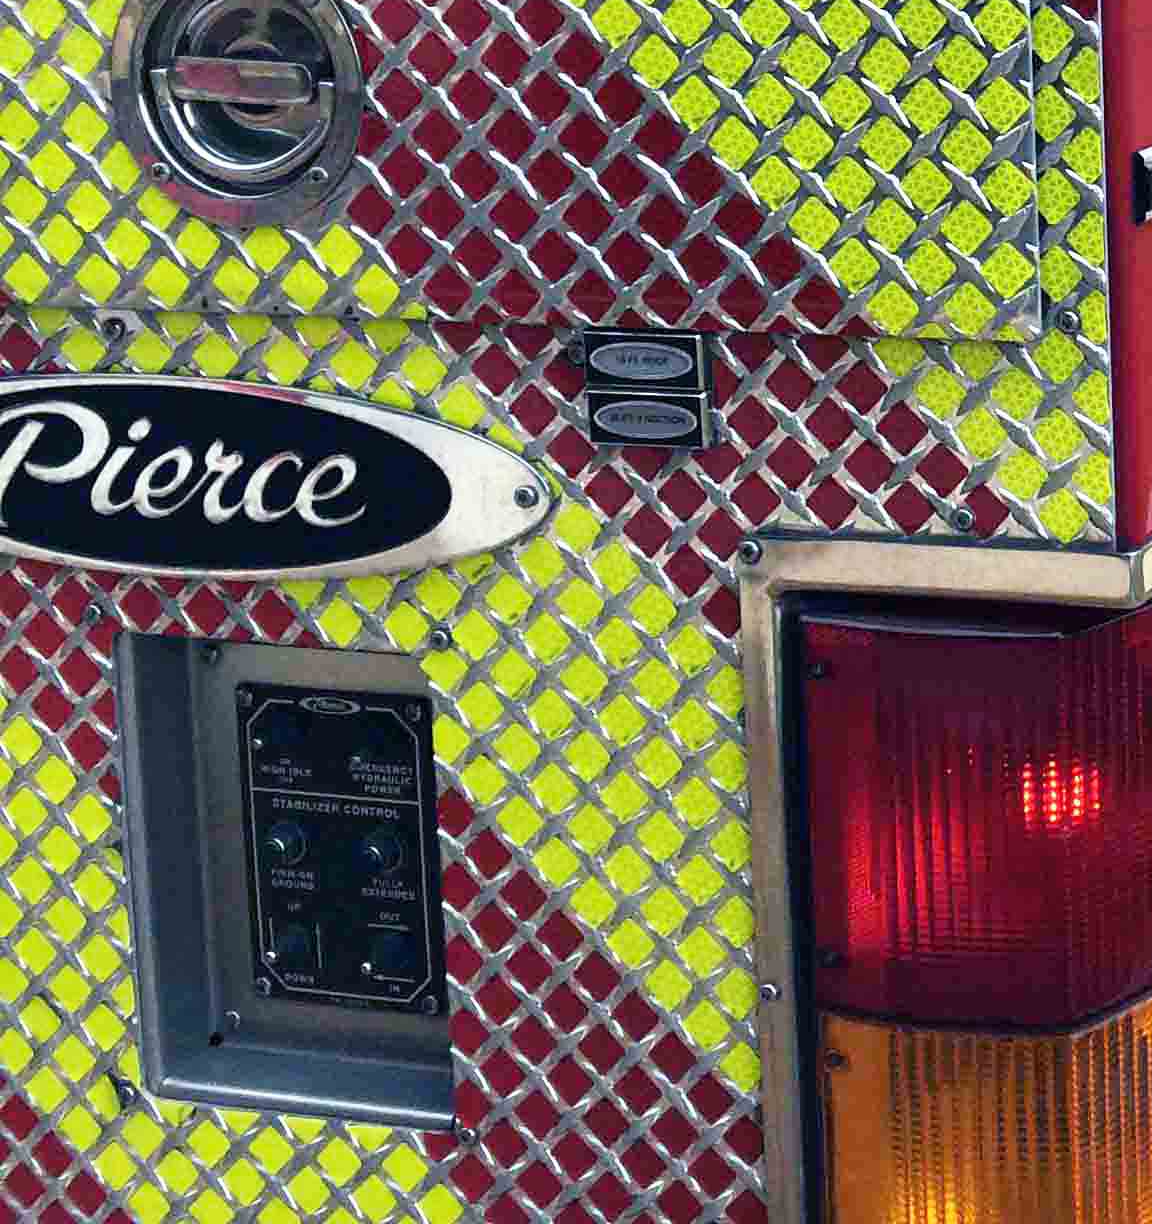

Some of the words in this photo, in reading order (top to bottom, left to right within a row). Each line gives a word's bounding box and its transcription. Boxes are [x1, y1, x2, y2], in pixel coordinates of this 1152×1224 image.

[0, 401, 367, 527] Pierce
[352, 773, 413, 785] HYDRAULIC
[271, 798, 340, 812] STABILIZER
[343, 805, 401, 820] CONTROL
